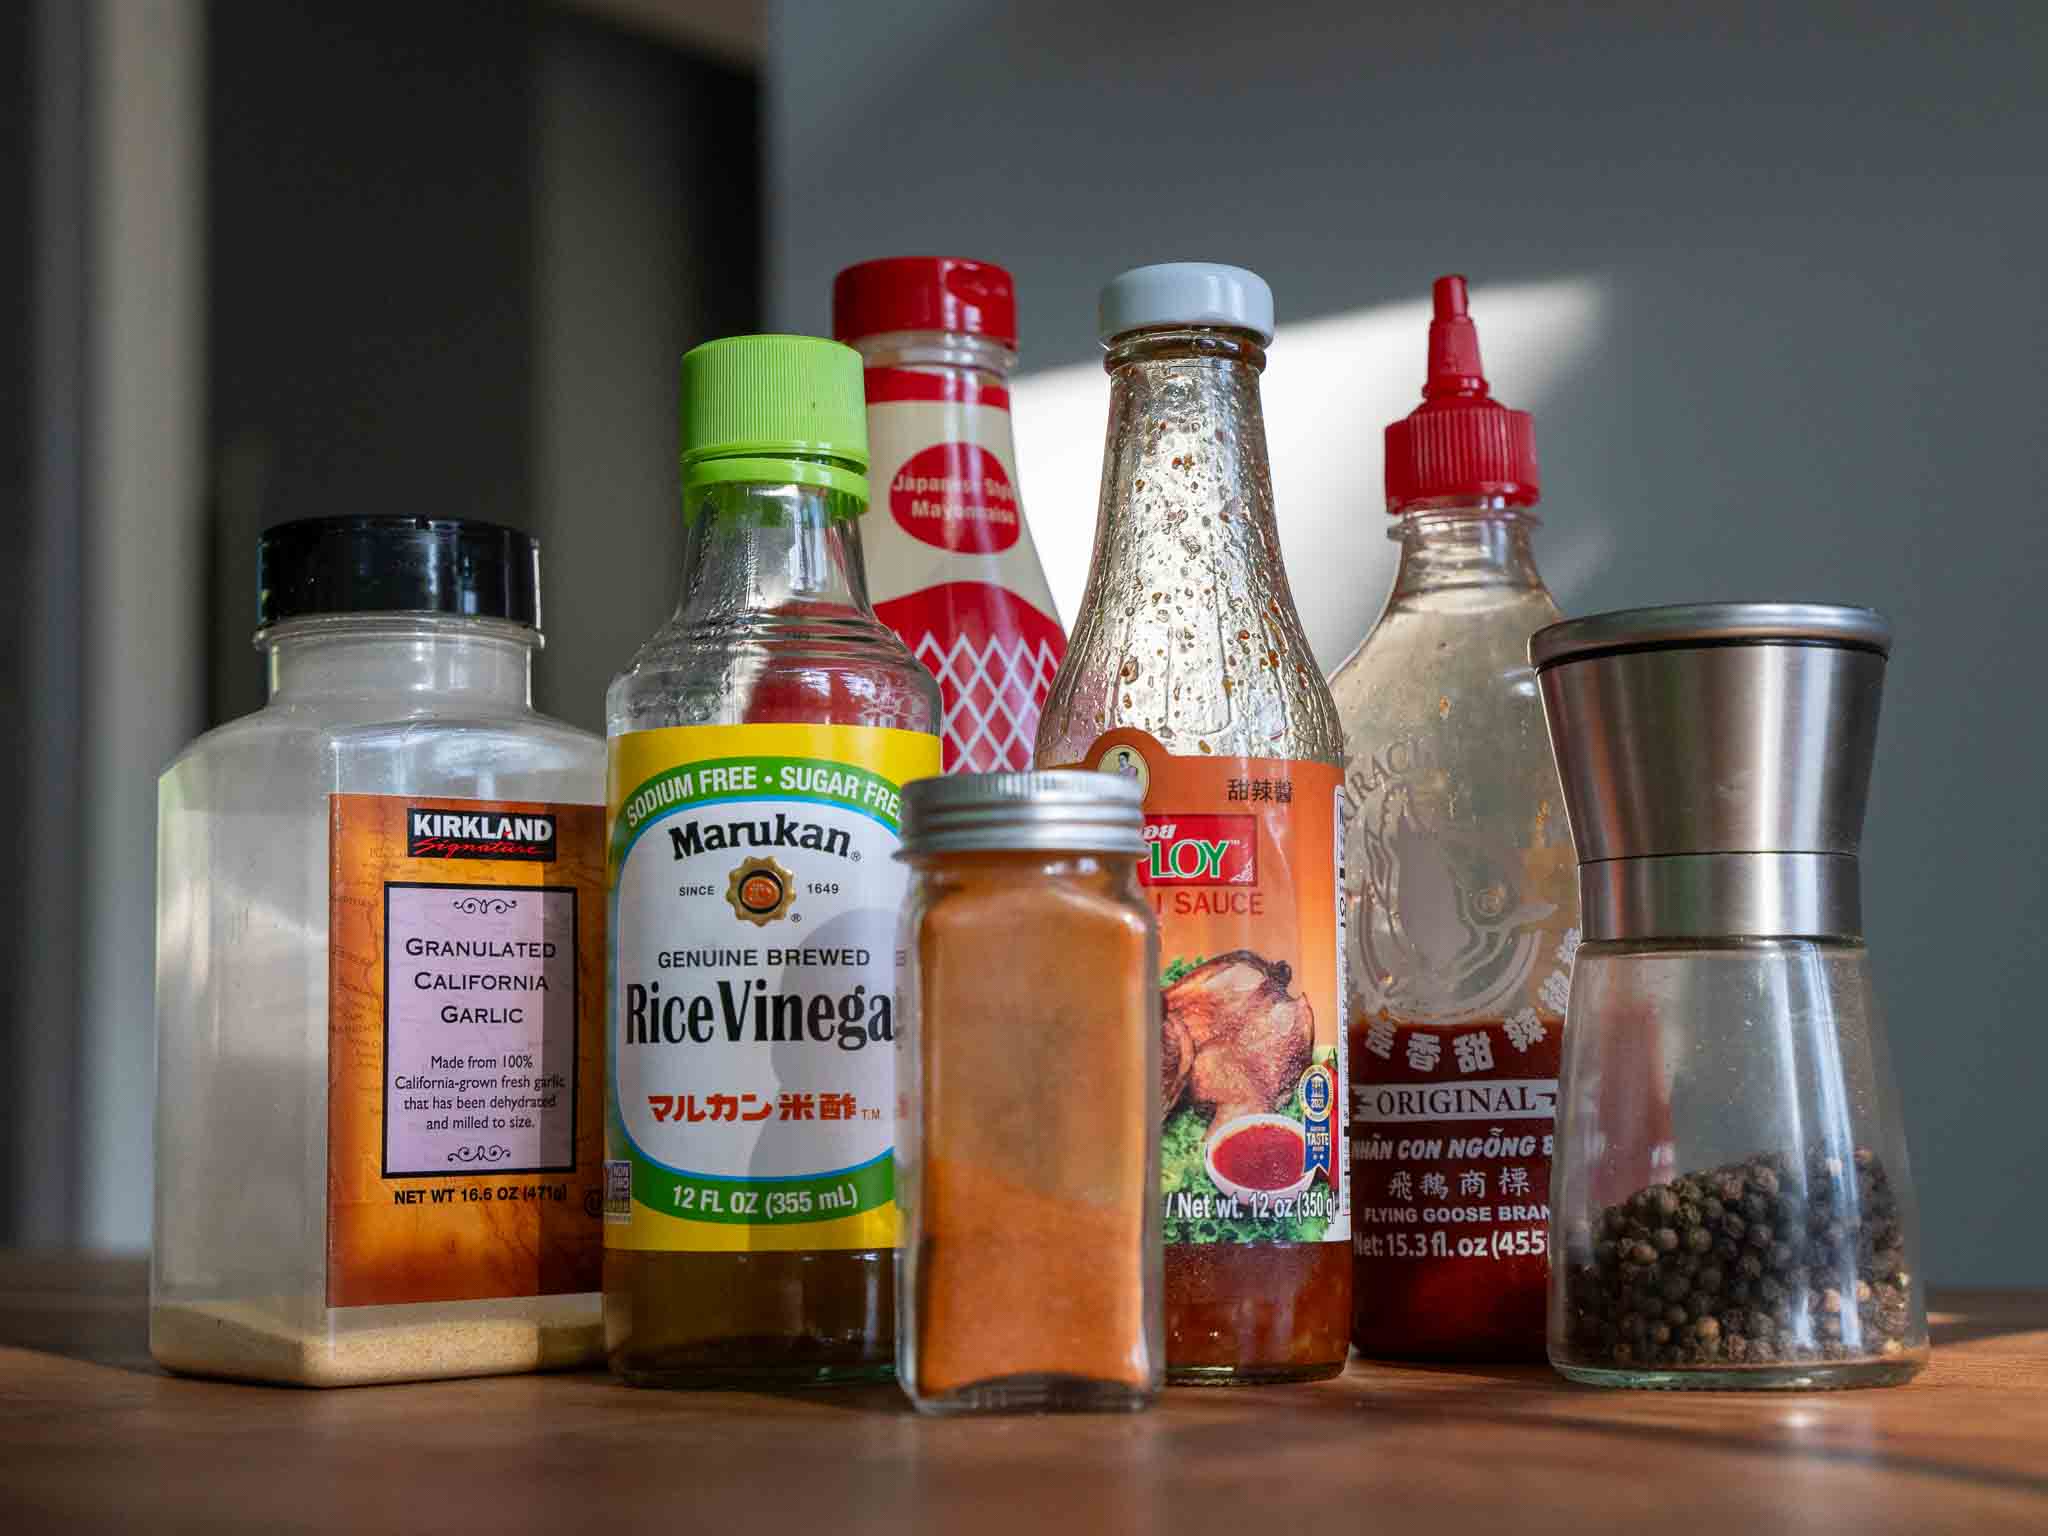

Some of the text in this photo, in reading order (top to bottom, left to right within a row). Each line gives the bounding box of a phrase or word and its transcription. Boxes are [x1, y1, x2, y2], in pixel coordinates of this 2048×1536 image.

[626, 766, 902, 828] SODIUM FREE SUGAR FRE
[413, 814, 553, 841] KIRKLAND
[668, 814, 851, 861] Marukan
[412, 837, 545, 858] Signature
[1148, 839, 1230, 879] LOY
[679, 883, 839, 896] SINCE 1649
[1175, 891, 1264, 915] SAUCE
[406, 938, 556, 959] GRANULATED
[658, 949, 870, 969] GENUINE BREWED
[414, 972, 549, 991] CALIFORNIA
[441, 1006, 524, 1024] GARLIC
[626, 979, 895, 1051] Rice Vinega
[431, 1055, 533, 1069] Made from 100%
[395, 1075, 565, 1092] California-grown fresh garlic
[404, 1096, 556, 1112] that has been dehydrated
[1377, 1087, 1536, 1115] ORIGINAL
[426, 1117, 535, 1130] and milled to size.
[861, 1109, 880, 1120] TM
[1307, 1133, 1329, 1146] TASTE
[1399, 1139, 1442, 1160] CON
[394, 1185, 567, 1204] NET WT 16.6 OZ (471g)
[673, 1183, 858, 1218] 12 FL OZ (355 mL)
[1178, 1193, 1212, 1218] Net
[1215, 1196, 1243, 1218] wt.
[1250, 1193, 1269, 1217] 12
[1275, 1199, 1293, 1217] oz
[1297, 1191, 1323, 1223] (350
[1327, 1192, 1336, 1224] g)
[1365, 1205, 1550, 1223] FLYING GOOSE BRAN
[1386, 1232, 1428, 1257] 15.3
[1431, 1231, 1454, 1256] fl.
[1457, 1237, 1488, 1257] oz
[1491, 1229, 1550, 1260] (455
